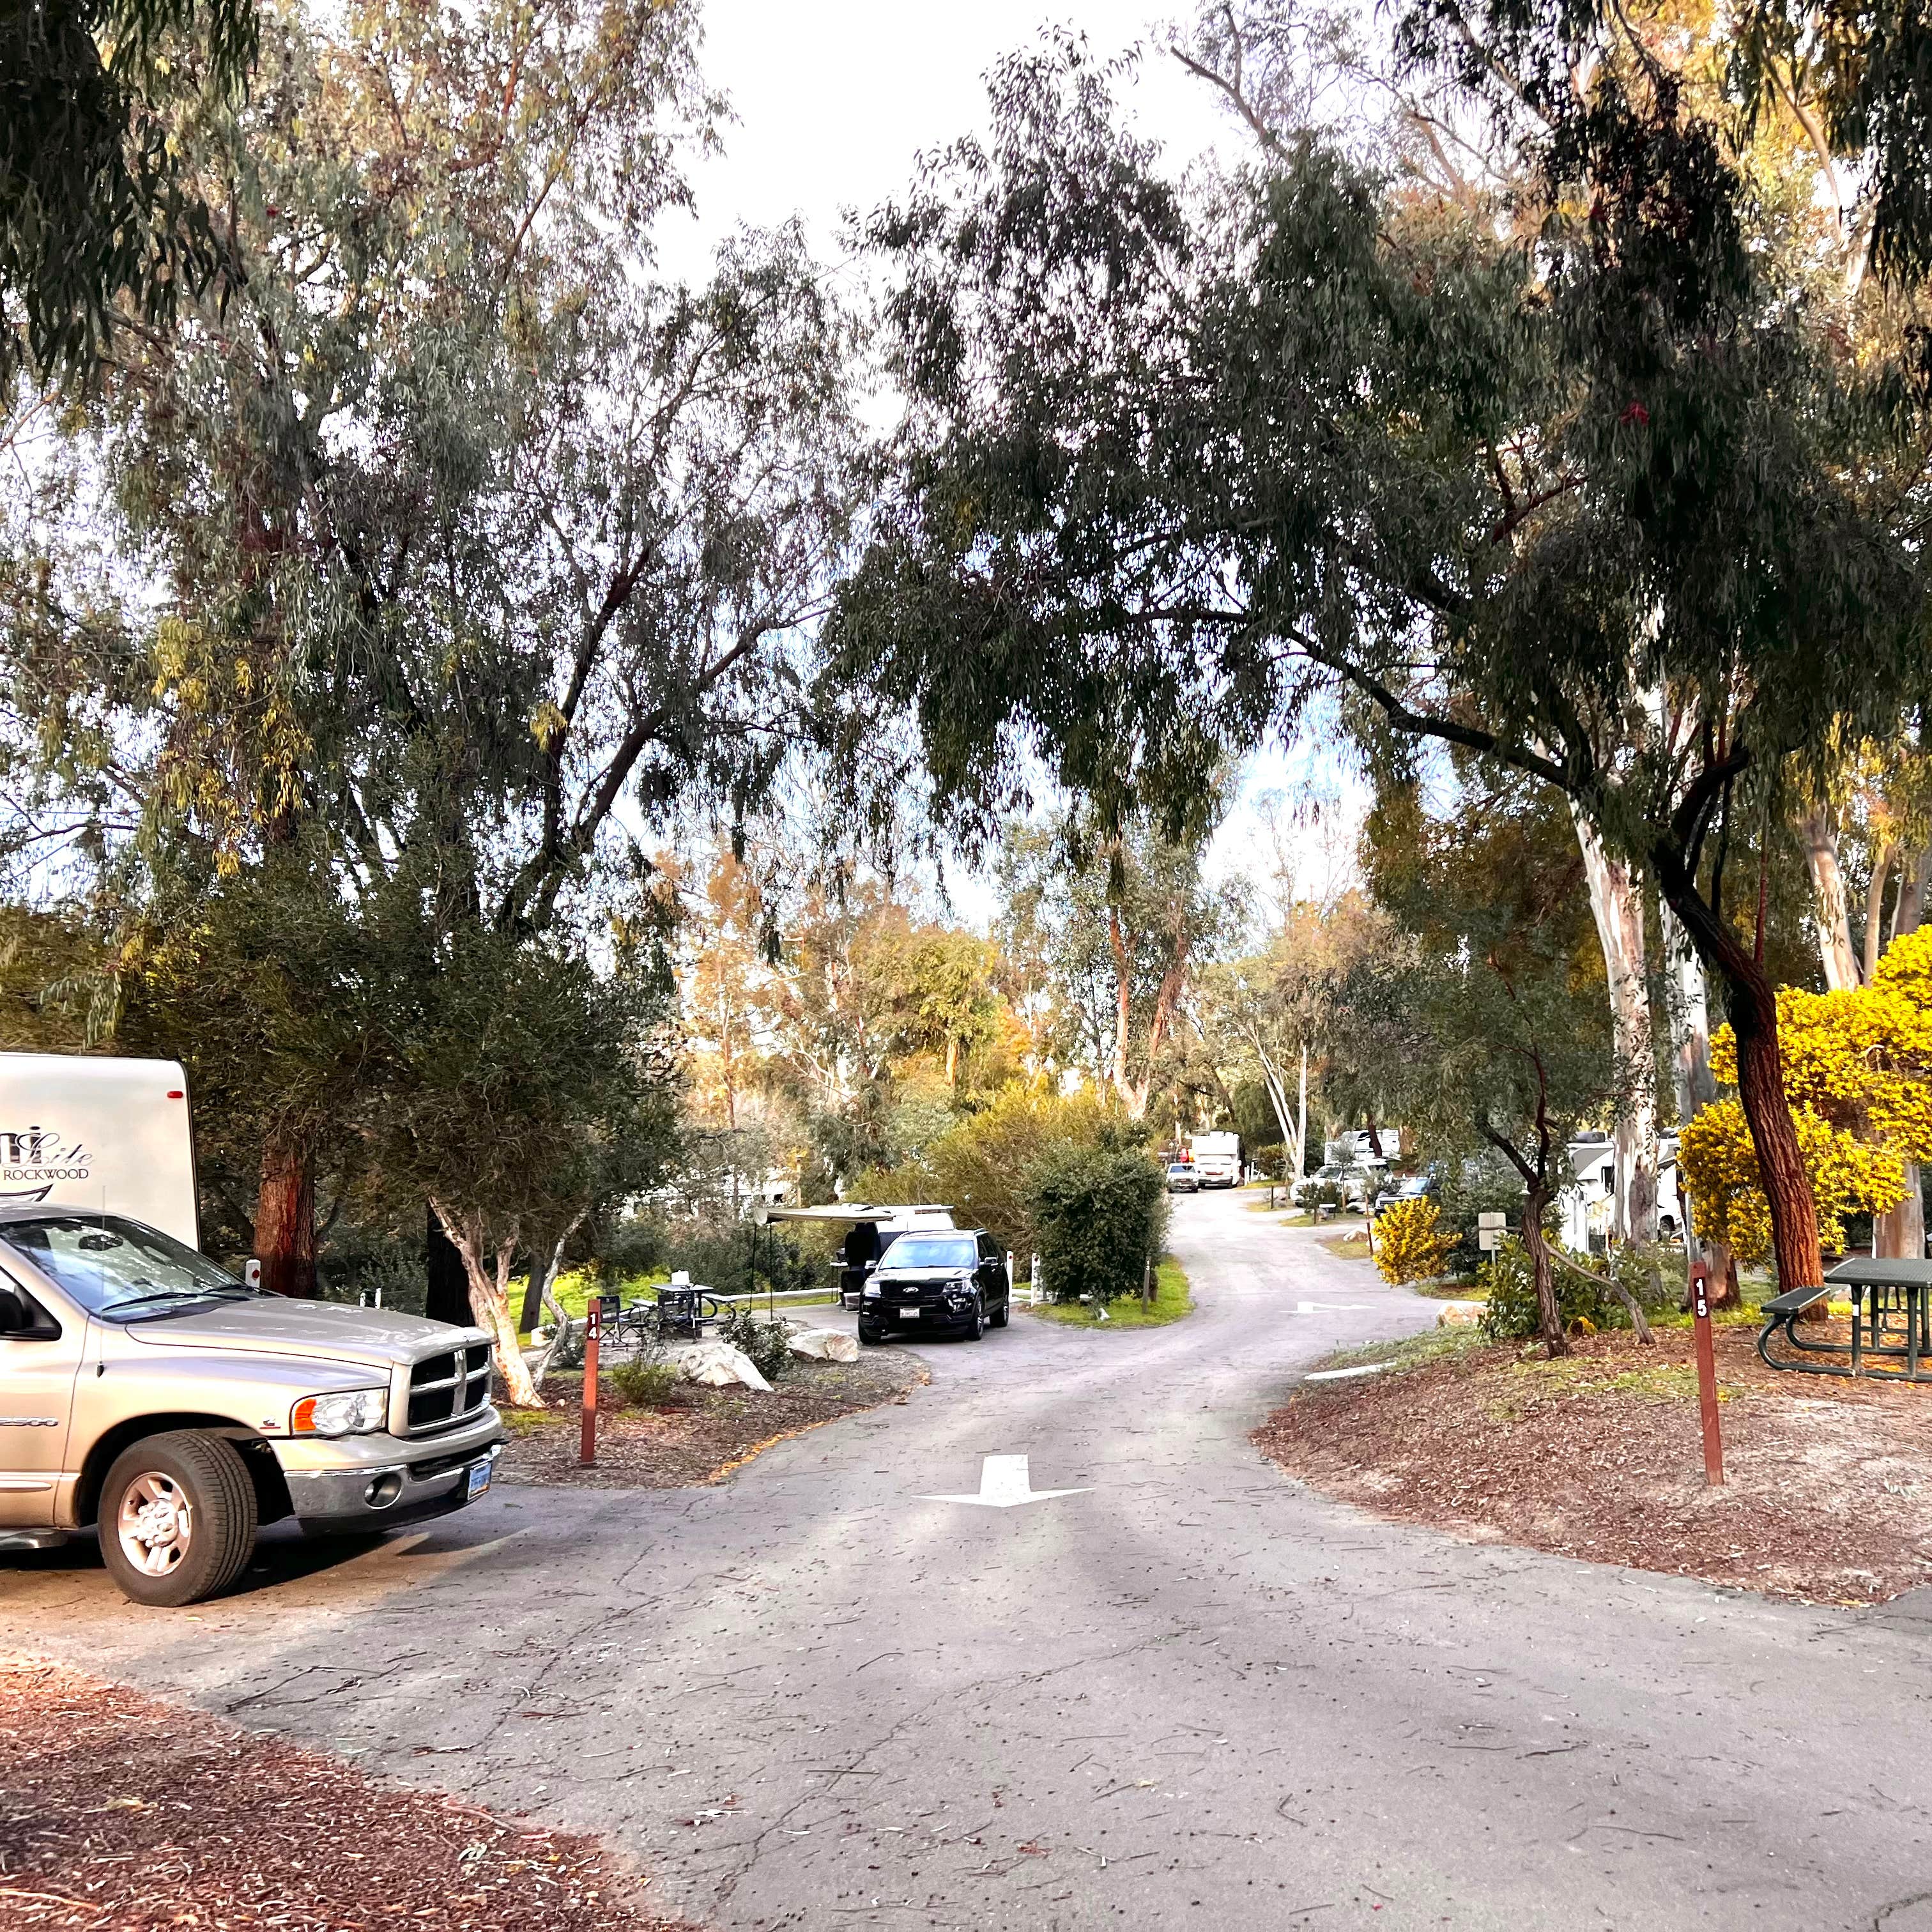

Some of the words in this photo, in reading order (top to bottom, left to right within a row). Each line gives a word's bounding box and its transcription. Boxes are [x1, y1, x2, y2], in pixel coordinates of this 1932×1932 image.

[1, 1133, 96, 1169] Lite
[3, 1169, 89, 1180] ROCKWOOD
[1696, 1278, 1707, 1317] 15
[588, 1313, 597, 1339] 14
